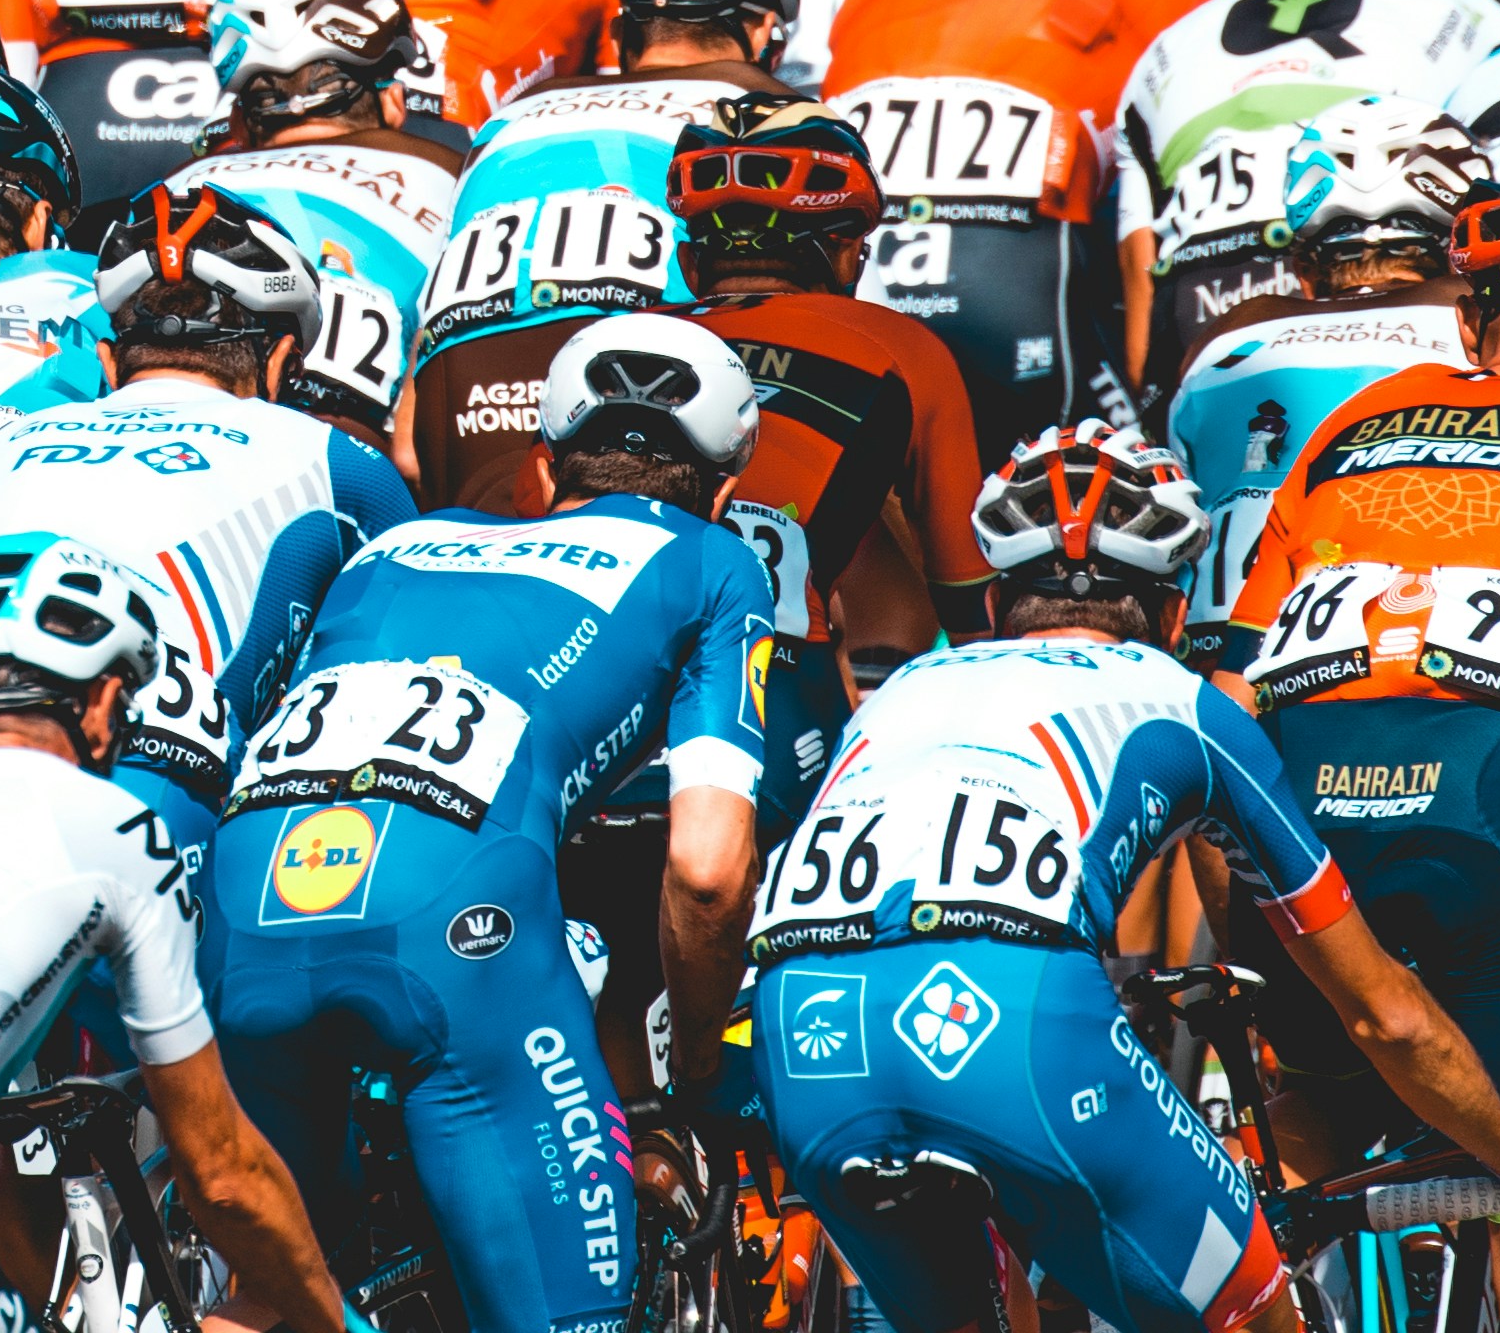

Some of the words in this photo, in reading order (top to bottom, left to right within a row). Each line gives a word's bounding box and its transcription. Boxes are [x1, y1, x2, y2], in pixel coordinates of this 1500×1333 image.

[98, 121, 203, 145] technologi
[925, 99, 1042, 180] 127
[790, 190, 853, 208] RUDY
[550, 202, 665, 270] 113
[324, 293, 388, 387] 12
[1269, 333, 1451, 354] MONDIALE
[1374, 320, 1417, 334] LA
[8, 418, 250, 446] Groupama
[456, 407, 541, 436] MOND
[11, 444, 126, 473] FDJ
[728, 501, 788, 528] LBRELLI
[1280, 574, 1359, 647] 96
[526, 616, 600, 691] latexco
[1272, 658, 1369, 698] MONTRÉAL
[384, 675, 486, 765] 23
[1316, 762, 1443, 797] BAHRAIN
[376, 773, 477, 821] MONTRÉAL
[1313, 794, 1436, 819] MERIDA
[282, 838, 364, 872] LIDL
[938, 792, 1070, 900] 156
[457, 933, 506, 952] vermarc
[768, 923, 872, 953] MONTRÉAL
[1108, 1012, 1252, 1215] Groupama
[533, 1121, 569, 1205] FLOORS
